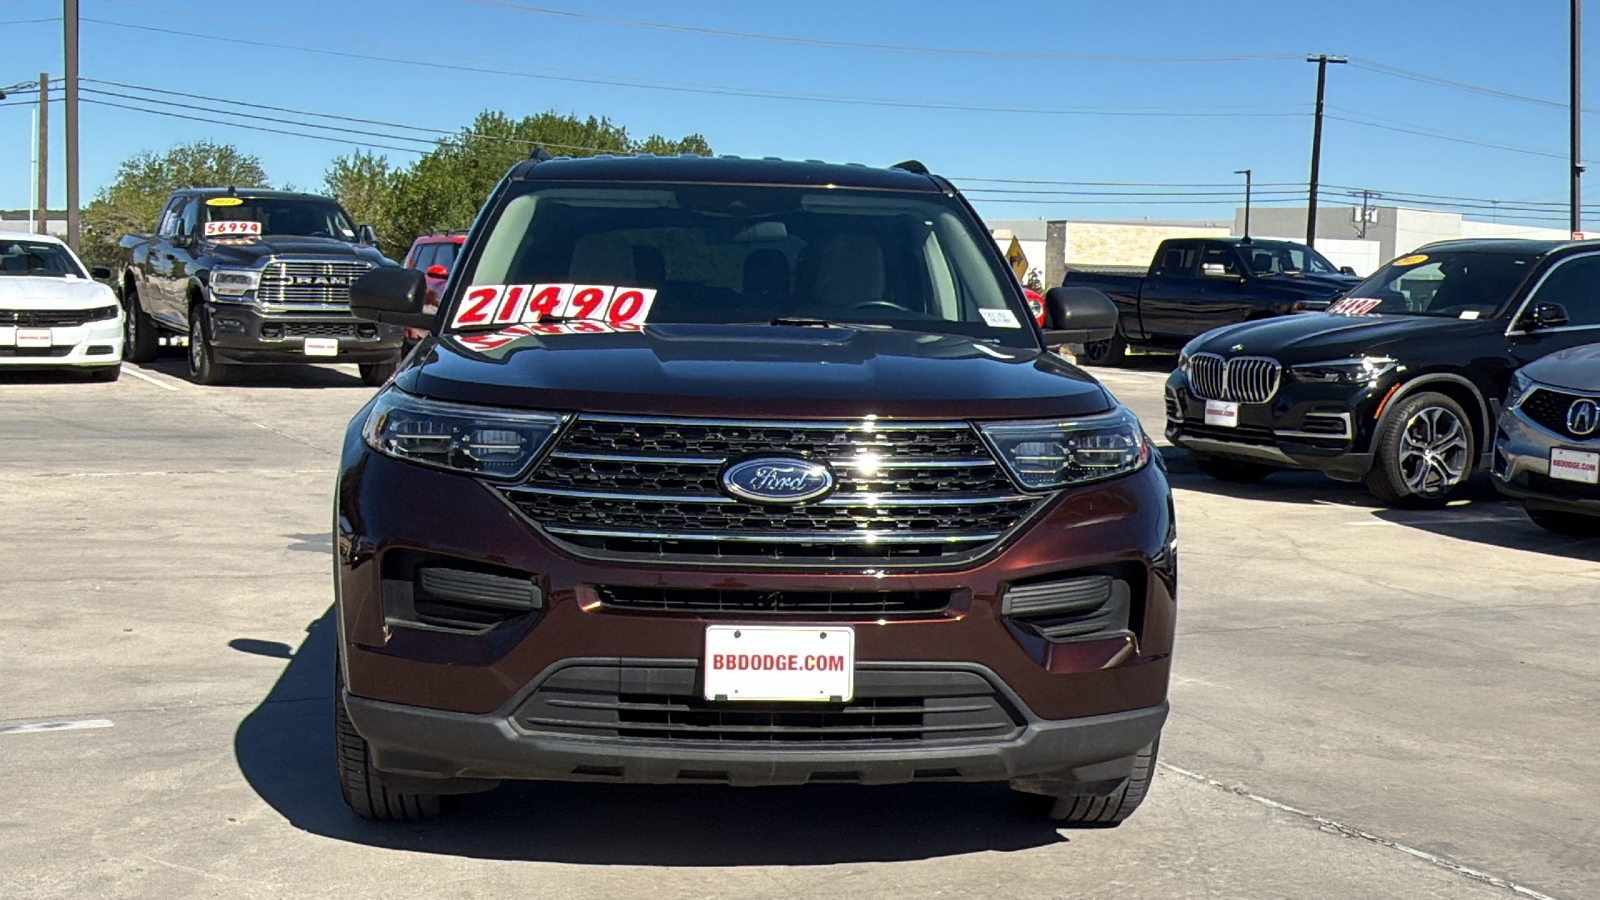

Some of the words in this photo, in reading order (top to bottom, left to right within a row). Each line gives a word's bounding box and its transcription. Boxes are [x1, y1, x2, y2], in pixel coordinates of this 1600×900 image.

[457, 287, 645, 323] 21490
[1553, 460, 1596, 471] BBDODGE.COM
[750, 467, 806, 491] Ford
[713, 654, 844, 672] BBDODGE.COM
